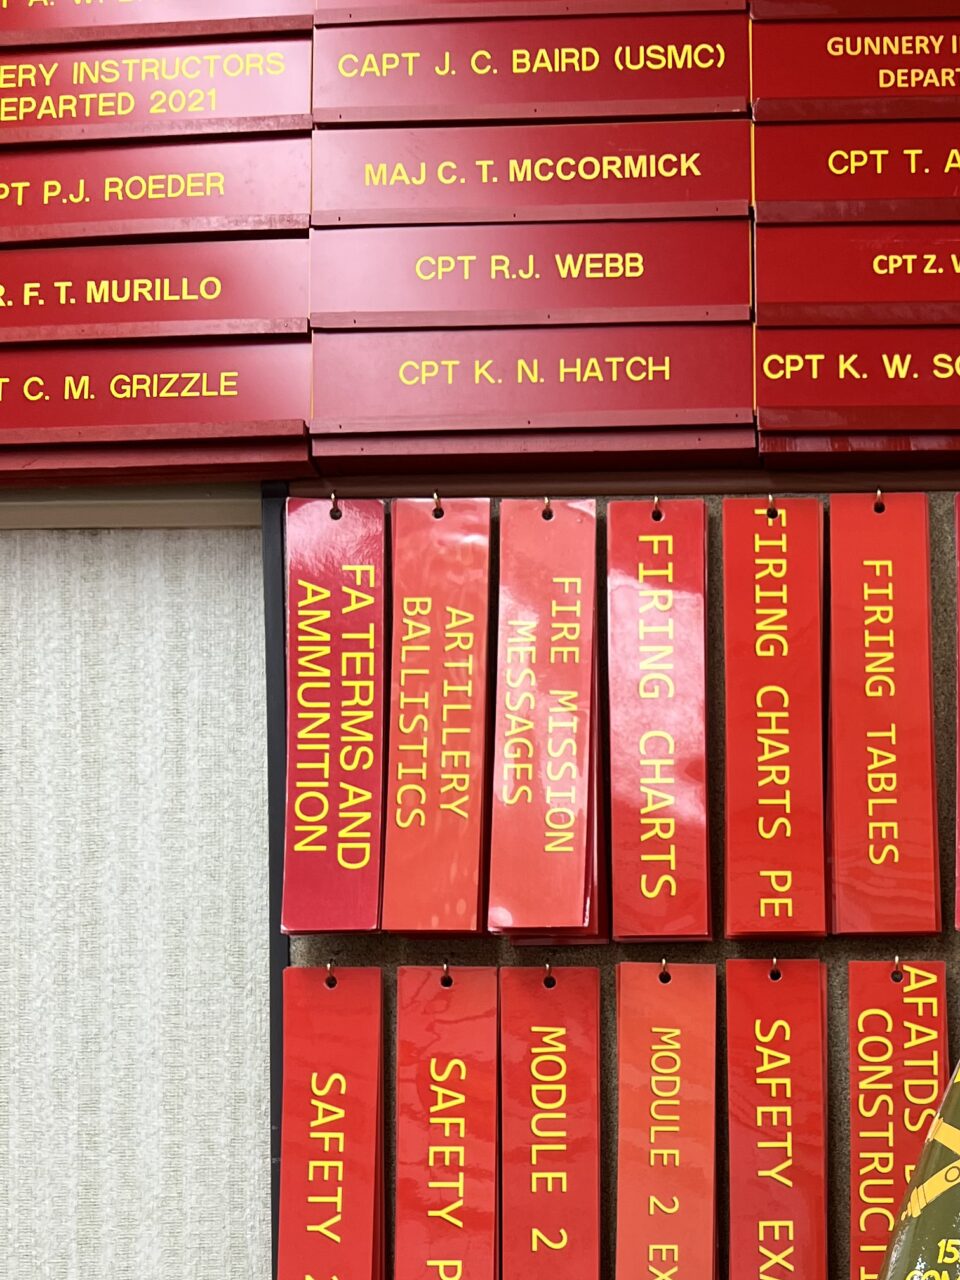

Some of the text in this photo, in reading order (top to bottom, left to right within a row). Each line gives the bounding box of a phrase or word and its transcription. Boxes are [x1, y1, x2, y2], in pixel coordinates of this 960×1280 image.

[72, 51, 285, 85] INSTRUCTORS
[337, 43, 726, 78] CAPT J. C. BAIRD (USMC)
[826, 35, 944, 56] GUNNERY
[149, 88, 217, 114] 2021
[43, 179, 91, 205] P.J.
[104, 172, 225, 202] ROEDER
[364, 153, 701, 186] MAJ C. T. MCCORMICK
[828, 149, 889, 175] CPT
[903, 149, 929, 174] T.
[23, 282, 45, 306] F.
[53, 281, 76, 305] T.
[86, 276, 222, 304] MURILLO
[415, 252, 645, 281] CPT R.J. WEBB
[872, 254, 917, 275] CPT
[923, 254, 944, 274] Z.
[23, 376, 50, 401] C.
[64, 375, 95, 400] M.
[109, 371, 239, 399] GRIZZLE
[399, 355, 670, 385] CPT K. N. HATCH
[762, 354, 825, 380] CPT
[838, 354, 867, 379] K.
[881, 353, 919, 379] W.
[293, 579, 332, 852] AMMUNITION
[336, 564, 376, 870] FA TERMS AND
[395, 596, 433, 829] BALLISTICS
[439, 606, 476, 819] ARTILLERY
[504, 621, 537, 806] MESSAGES
[543, 576, 582, 853] FIRE MISSION
[638, 534, 677, 899] FIRING CHARTS
[754, 508, 793, 918] FIRING CHARTS PE
[862, 559, 900, 865] FIRING TABLES
[902, 964, 940, 1132] AFATDS
[530, 1025, 568, 1193] MODULE
[649, 1026, 682, 1167] MODULE
[754, 1019, 793, 1188] SAFETY
[306, 1071, 347, 1243] SAFETY
[427, 1057, 467, 1228] SAFETY
[531, 1227, 569, 1252] 2
[649, 1195, 680, 1216] 2
